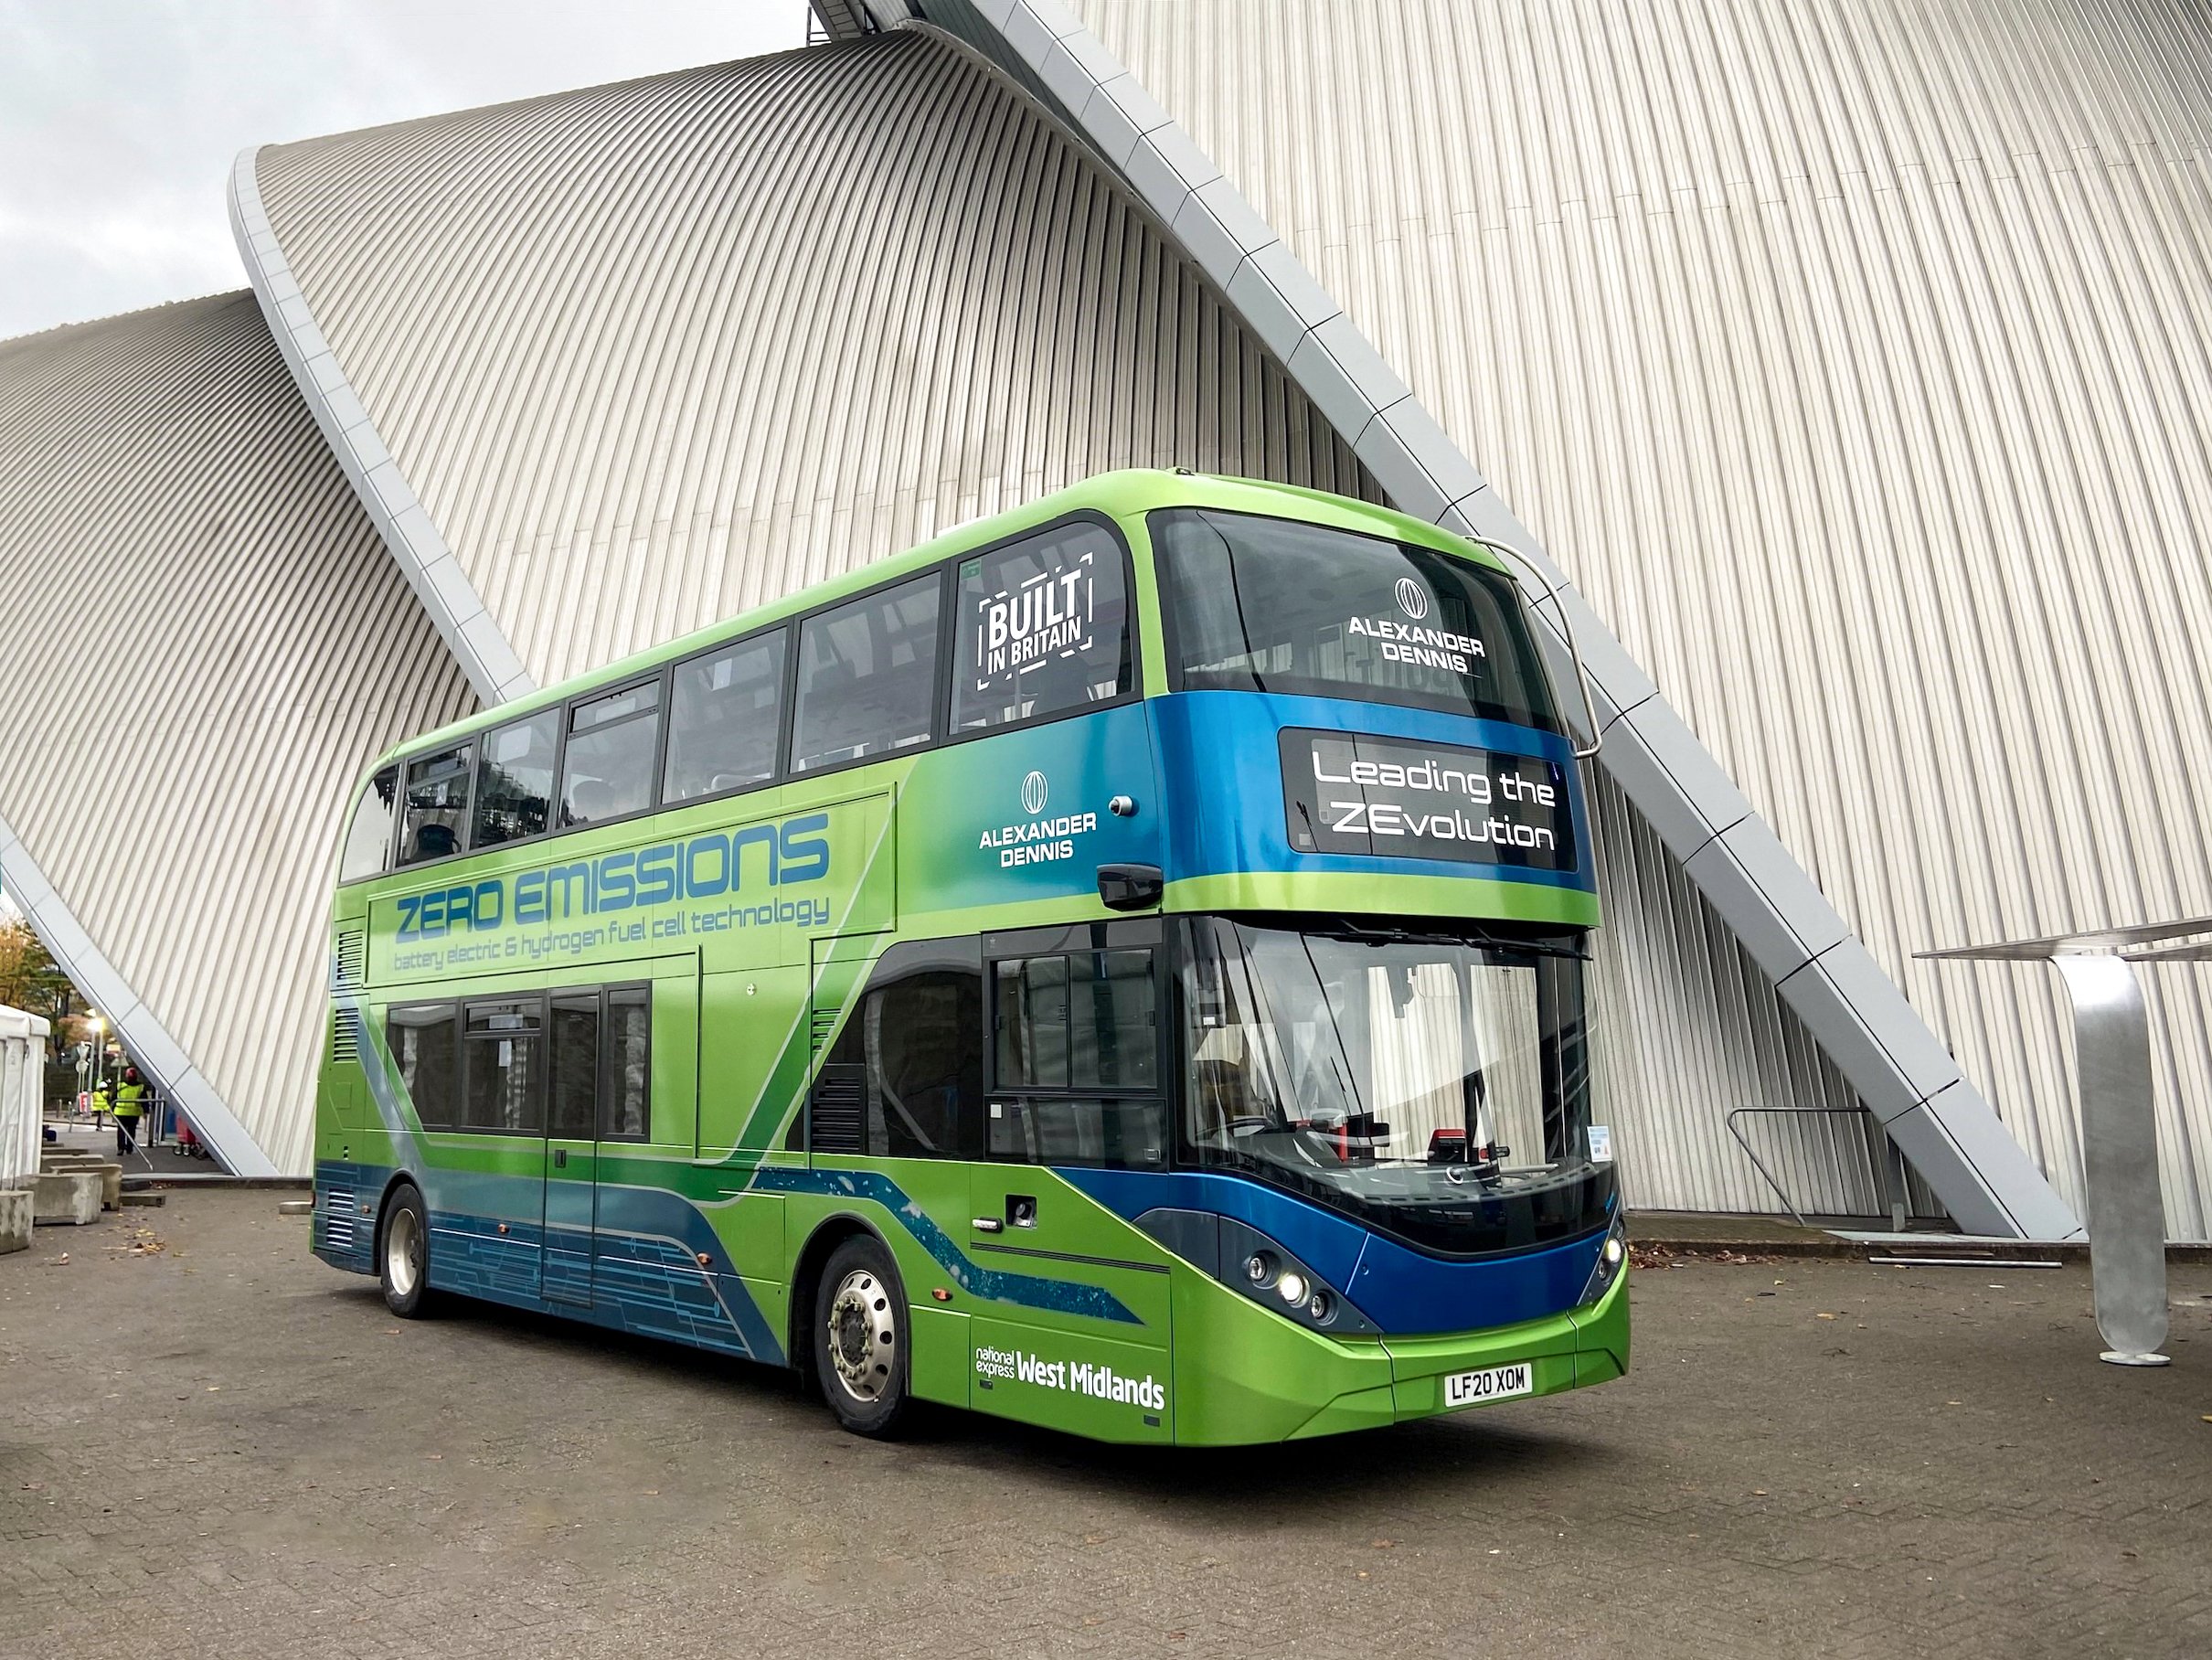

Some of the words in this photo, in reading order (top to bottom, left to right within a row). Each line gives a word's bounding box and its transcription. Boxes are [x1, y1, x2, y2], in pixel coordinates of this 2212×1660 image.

[988, 569, 1082, 651] BUILT
[987, 646, 1006, 676] IN
[1011, 615, 1082, 665] BRITAIN
[1348, 616, 1486, 659] ALEXANDER
[1381, 642, 1469, 675] DENNIS
[1313, 750, 1491, 804] Leading
[1500, 771, 1555, 807] the
[979, 813, 1097, 849] ALEXANDER
[1330, 800, 1556, 851] ZEvolution
[1001, 839, 1074, 867] DENNIS
[395, 879, 504, 944] ZERO
[515, 813, 830, 924] EMISSIONS
[394, 949, 444, 972] battery
[447, 939, 500, 965] electric
[505, 937, 517, 957] &
[521, 925, 605, 959] hydrogen
[609, 920, 647, 944] fuel
[652, 910, 686, 938] cell
[691, 897, 831, 932] technology
[975, 1346, 1015, 1366] national
[975, 1360, 1015, 1379] express
[1016, 1351, 1067, 1390] West
[1069, 1361, 1165, 1410] Midlands
[1452, 1372, 1493, 1399] LF20
[1496, 1367, 1526, 1392] XOM
